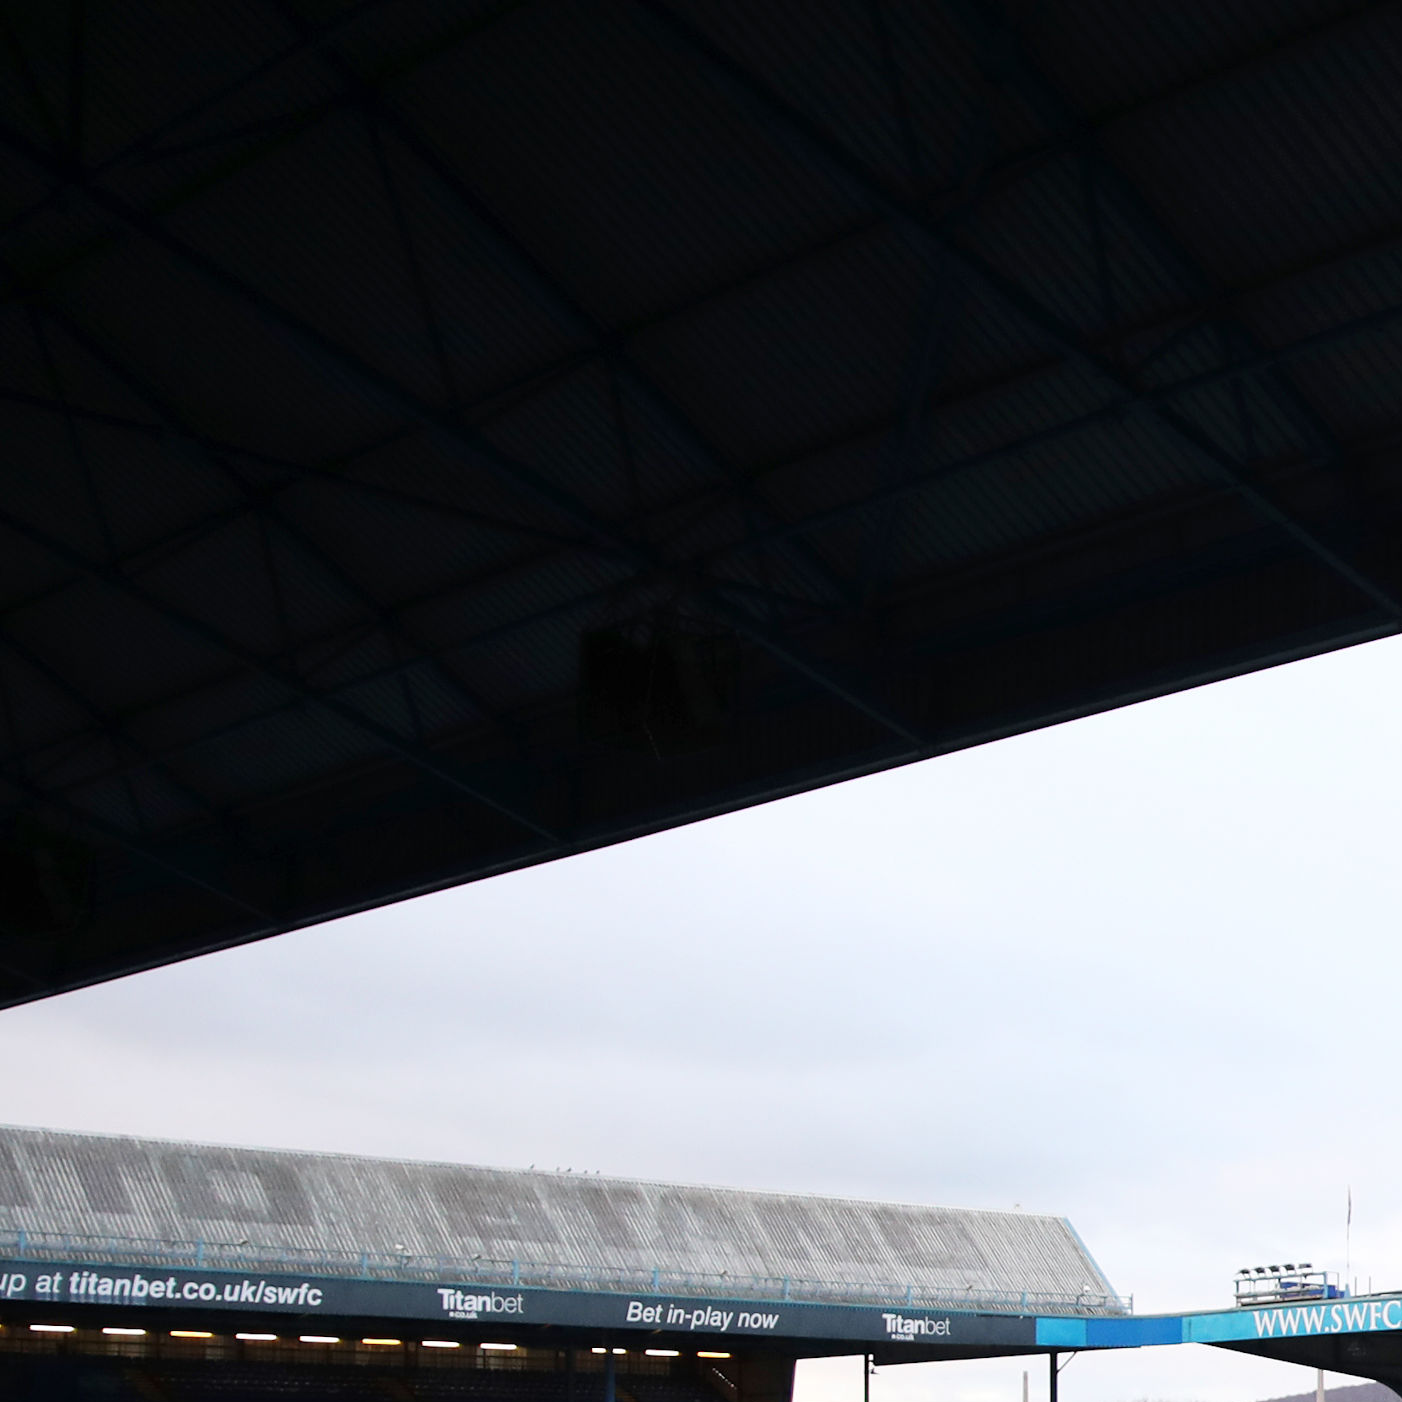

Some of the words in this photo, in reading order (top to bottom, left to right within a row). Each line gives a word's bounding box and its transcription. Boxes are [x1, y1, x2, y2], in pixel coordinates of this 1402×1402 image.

[35, 1273, 62, 1293] at
[69, 1270, 324, 1307] titanbet.co.uk/swfc
[437, 1288, 523, 1314] Titanbet
[626, 1302, 663, 1325] Bet
[667, 1303, 734, 1331] in-play
[737, 1310, 780, 1330] now
[881, 1313, 951, 1336] Titanbet
